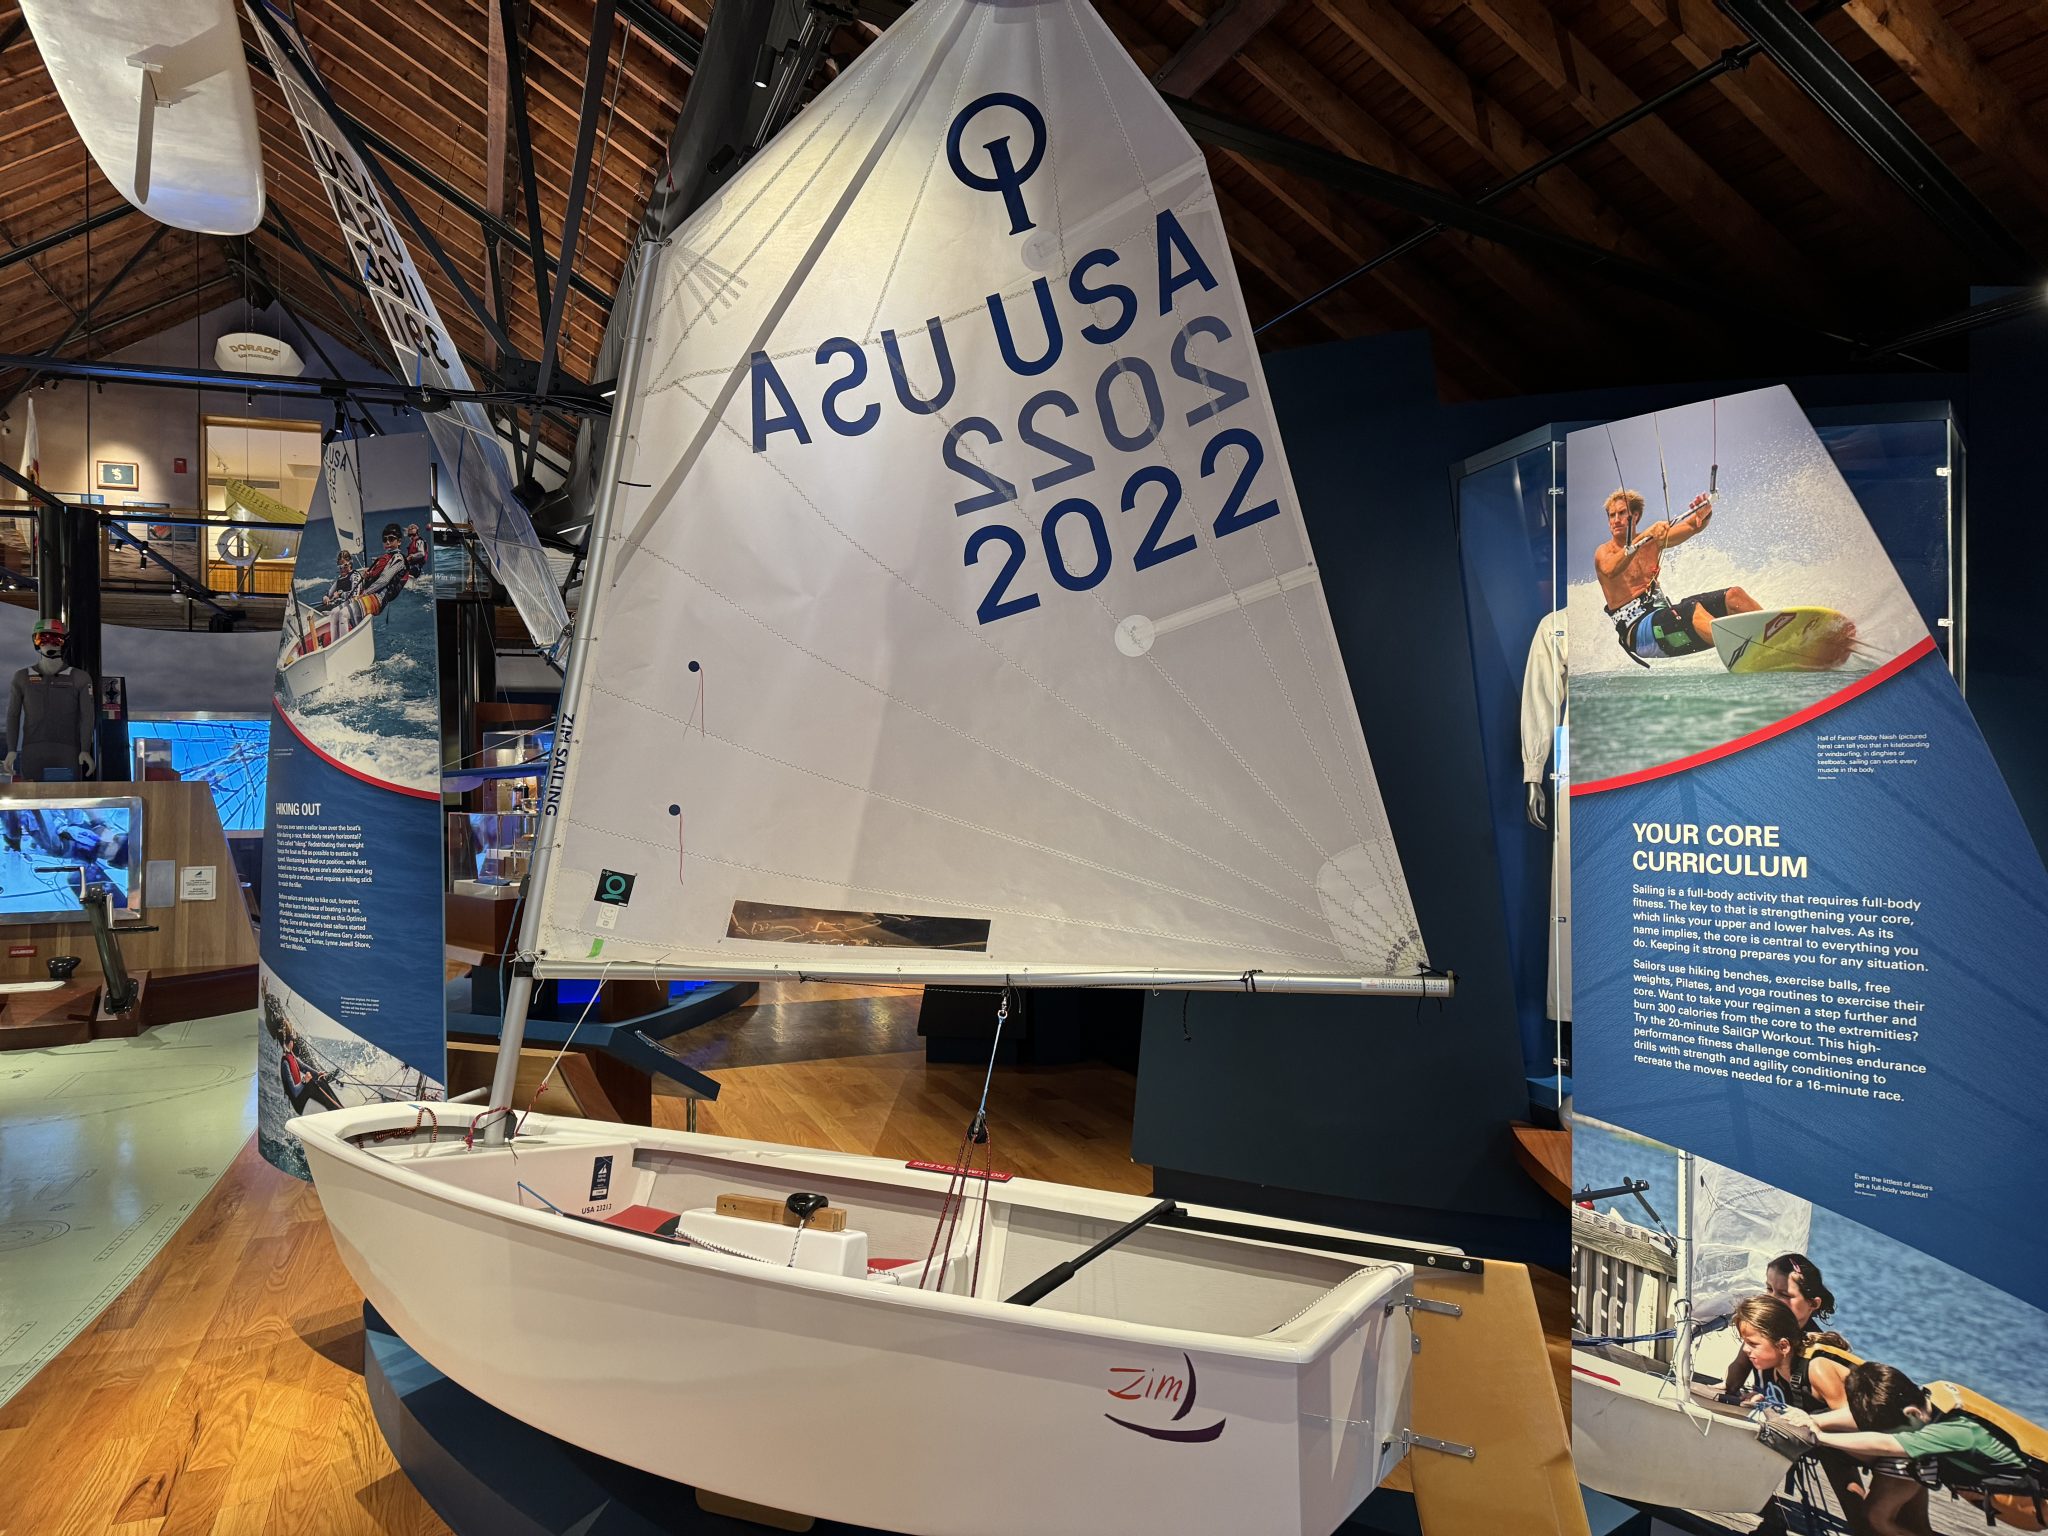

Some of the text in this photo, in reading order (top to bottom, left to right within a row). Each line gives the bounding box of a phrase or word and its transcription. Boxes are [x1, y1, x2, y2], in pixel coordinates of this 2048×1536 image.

[985, 208, 1219, 376] USA
[229, 343, 281, 357] DORADE
[329, 446, 347, 472] USA
[963, 428, 1281, 626] 2022
[545, 713, 574, 817] ZIM SAILING
[275, 803, 321, 816] HIKING OUT
[1632, 822, 1779, 847] YOUR CORE
[1632, 850, 1807, 878] CURRICULUM
[1632, 883, 1665, 897] Sailing
[1667, 886, 1676, 896] is
[1687, 887, 1734, 902] full-body
[1736, 891, 1778, 904] activity
[1780, 892, 1804, 904] that
[1807, 895, 1858, 907] requires
[1861, 896, 1921, 911] full-body
[1632, 897, 1914, 926] fitness. The key to that is strengthening your core,
[1632, 911, 1894, 939] which links your upper and lower halves. As its
[1633, 926, 1918, 956] name implies, the core is central to everything you
[1632, 937, 1928, 971] do. Keeping it strong prepares you for any situation.
[1633, 958, 1890, 993] Sailors use hiking benches, exercise balls, free
[1633, 973, 1925, 1011] weights, Pilates, and yoga routines to exercise their
[1633, 987, 1916, 1026] core. Want to take your regimen a step further and
[1633, 998, 1919, 1042] burn 300 calories from the core to the extremities?
[1633, 1011, 1881, 1054] Try the 20-minute SailGP Workout. This high-
[1633, 1027, 1926, 1073] performance fitness challenge combines endurance
[1633, 1039, 1886, 1084] drills with strength and agility conditioning to
[1634, 1054, 1904, 1102] recreate the moves needed for a 16-minute race.
[1854, 1173, 1870, 1181] Even
[1882, 1177, 1903, 1187] littlest
[1911, 1183, 1933, 1191] sailors
[1854, 1181, 1865, 1189] get
[1871, 1183, 1898, 1194] full-body
[1899, 1190, 1928, 1198] workout!
[581, 1206, 595, 1214] USA
